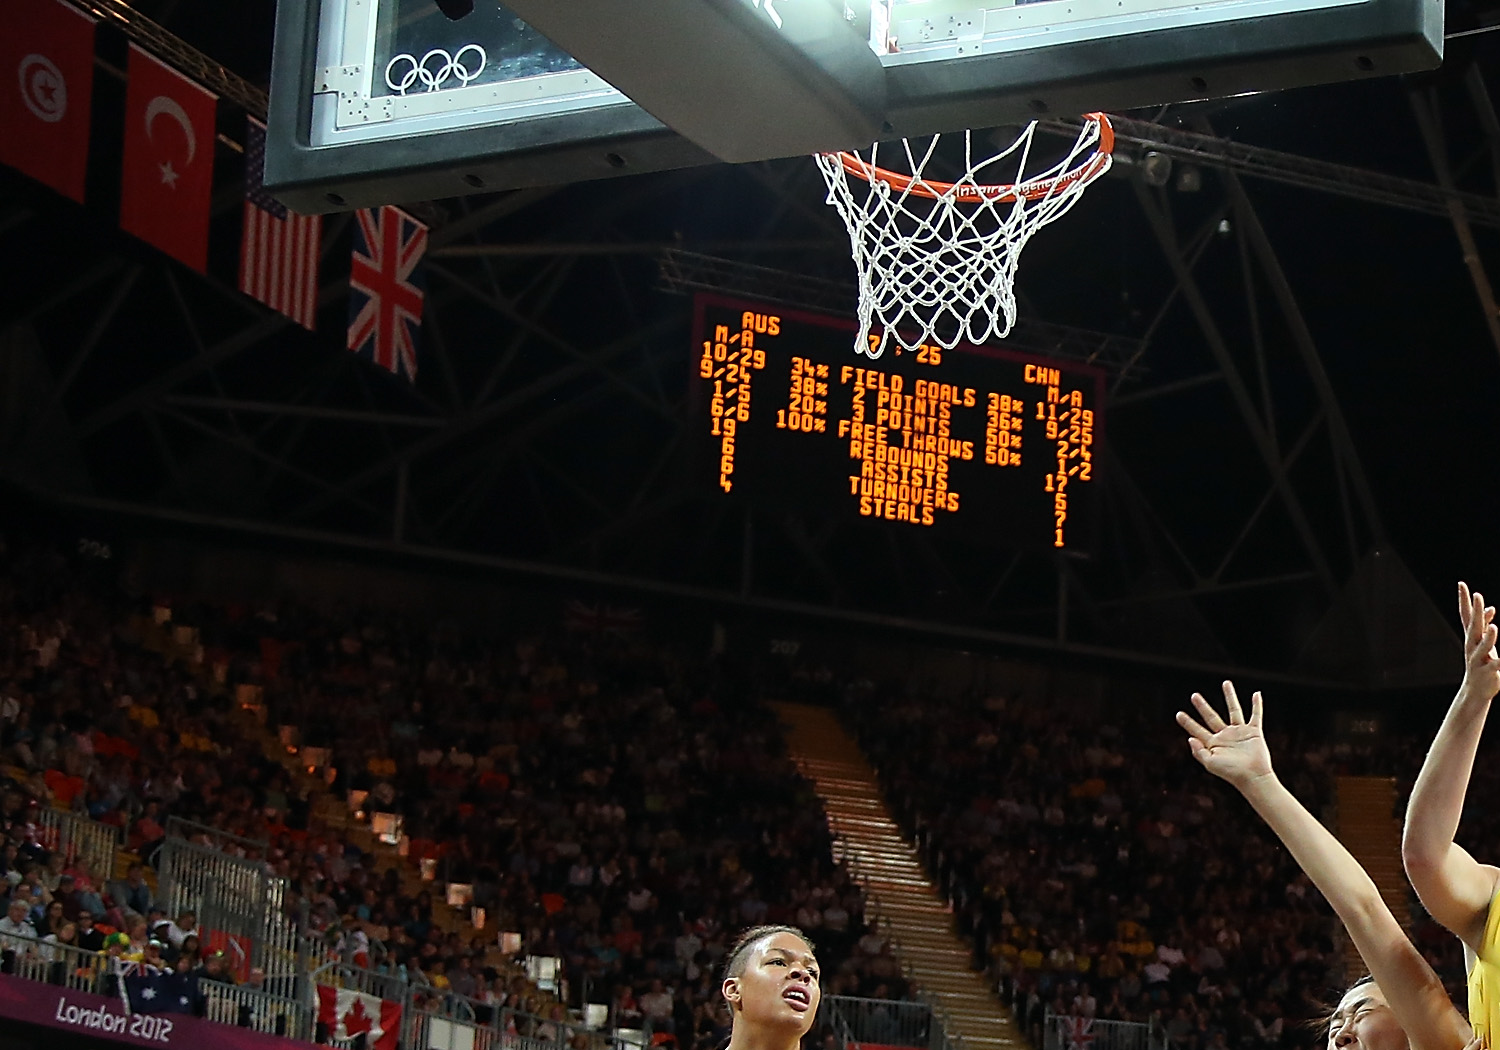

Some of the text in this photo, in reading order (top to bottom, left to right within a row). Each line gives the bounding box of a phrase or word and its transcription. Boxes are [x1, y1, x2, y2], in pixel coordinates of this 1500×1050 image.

[742, 311, 780, 335] AUS
[715, 325, 753, 347] M/A
[702, 341, 765, 369] 10/29
[916, 345, 941, 365] 25
[701, 359, 751, 384] 9/24
[791, 357, 829, 378] 34%
[1024, 364, 1060, 386] CHN
[714, 380, 750, 402] 1/5
[790, 375, 828, 396] 38%
[841, 366, 976, 406] FIELD GOALS
[1048, 386, 1082, 407] M/A
[711, 398, 749, 422] 6/6
[789, 393, 826, 414] 20%
[853, 387, 951, 419] 2 POINTS
[988, 393, 1023, 413] 38%
[776, 409, 826, 432] 100%
[852, 405, 950, 437] 3 POINTS
[987, 411, 1023, 431] 36%
[1036, 402, 1093, 427] 11/29
[711, 417, 736, 436] 19
[1046, 421, 1092, 445] 9/25
[722, 437, 734, 455] 6
[838, 420, 973, 460] FREE THROWS
[986, 428, 1022, 448] 50%
[850, 441, 948, 472] REBOUNDS
[985, 446, 1021, 466] 50%
[1057, 441, 1091, 462] 2/4
[721, 455, 733, 474] 6
[1058, 458, 1091, 480] 1/2
[720, 473, 732, 492] 4
[862, 461, 948, 491] ASSISTS
[1045, 474, 1067, 492] 17
[849, 476, 959, 511] TURNOVERS
[1055, 493, 1066, 510] 5
[860, 498, 934, 525] STEALS
[1055, 511, 1066, 528] 7
[1054, 529, 1064, 546] 1
[56, 997, 173, 1042] London 2012
